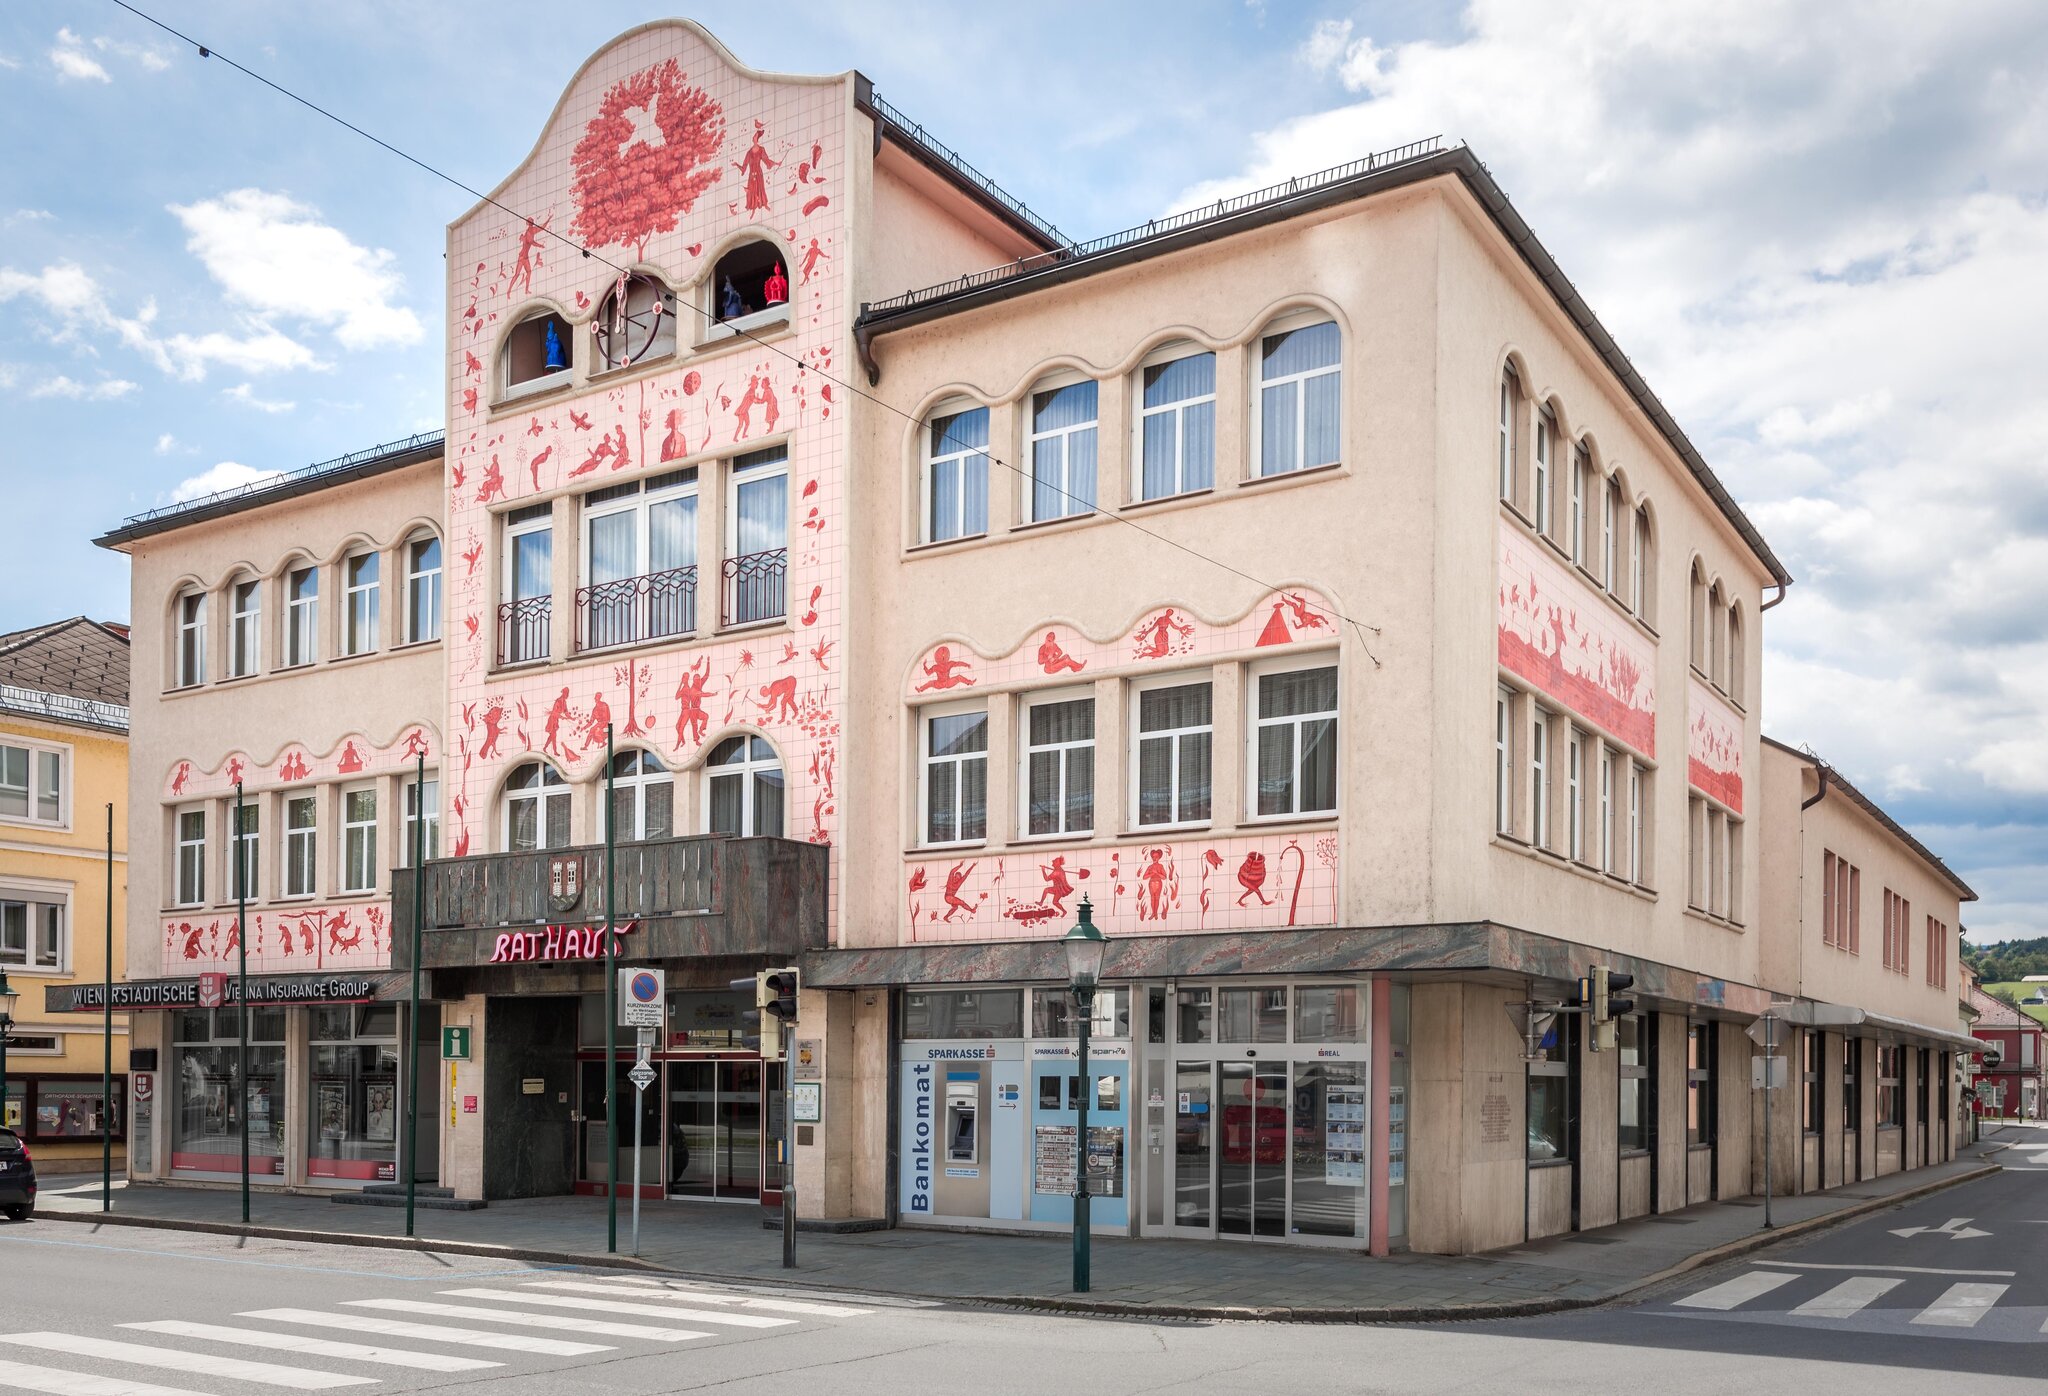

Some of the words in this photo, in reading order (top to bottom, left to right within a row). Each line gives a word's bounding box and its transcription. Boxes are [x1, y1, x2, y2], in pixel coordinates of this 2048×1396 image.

[72, 987, 119, 1004] WIENR
[329, 979, 369, 997] GROUP
[928, 1049, 985, 1059] SPARKASSE
[911, 1064, 931, 1212] Bankomat
